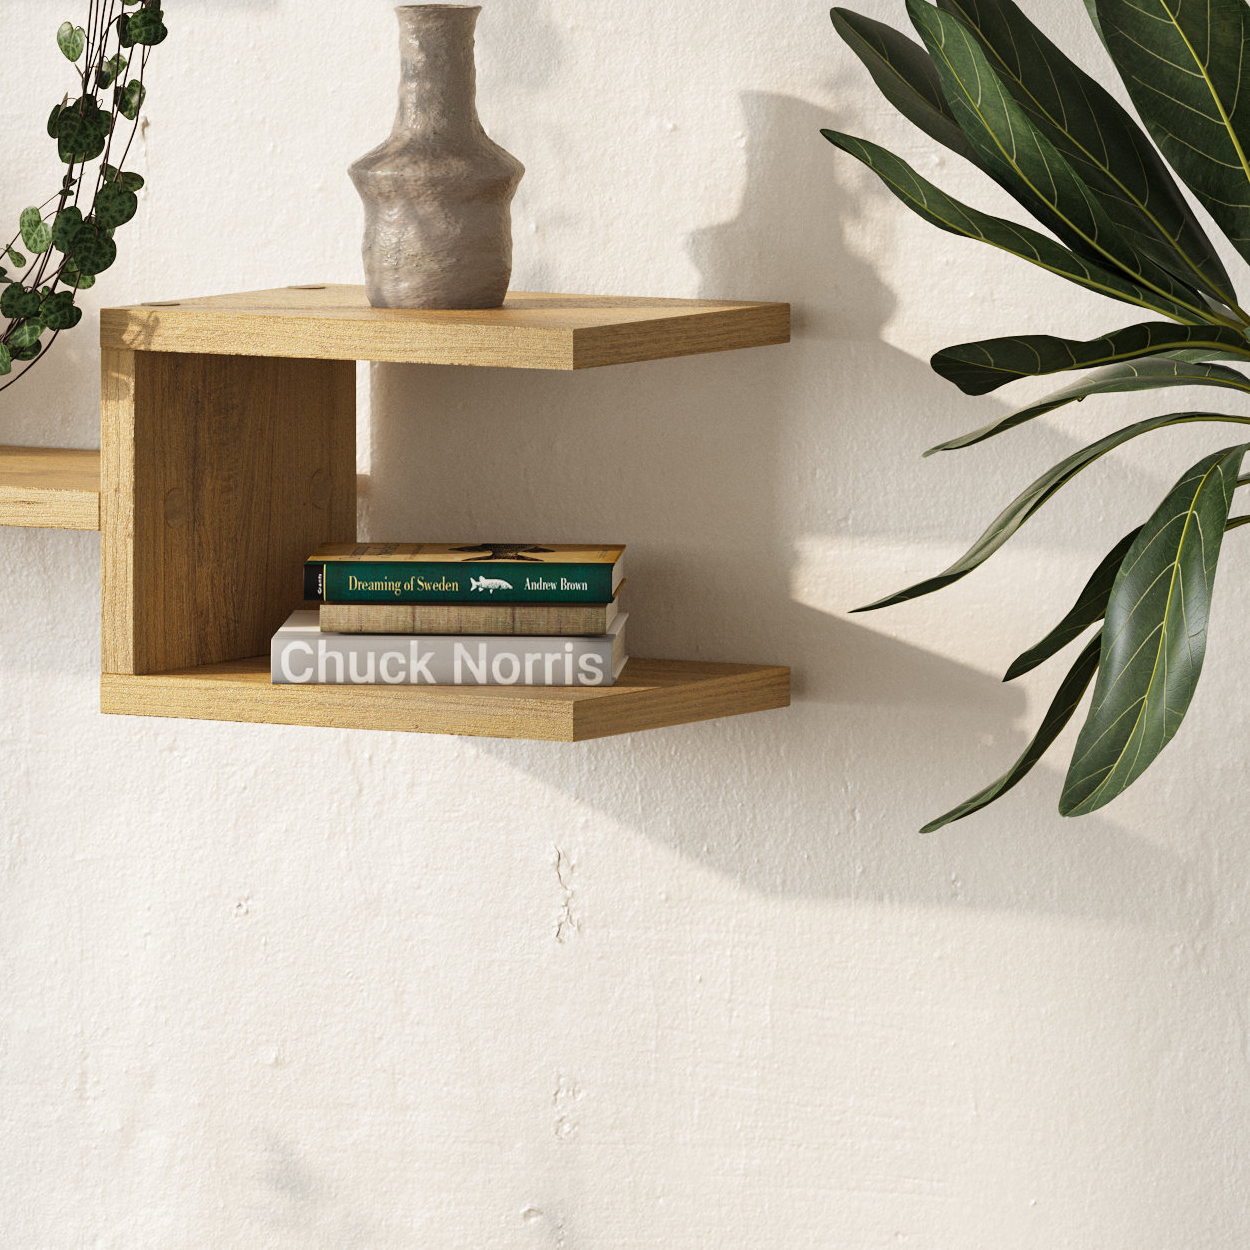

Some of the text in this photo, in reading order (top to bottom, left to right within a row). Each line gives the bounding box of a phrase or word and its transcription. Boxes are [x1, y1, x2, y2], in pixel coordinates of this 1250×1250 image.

[349, 576, 459, 596] Dreaming of Sweden
[524, 577, 588, 591] Andrew Brown
[280, 639, 604, 686] Chuck Norris
